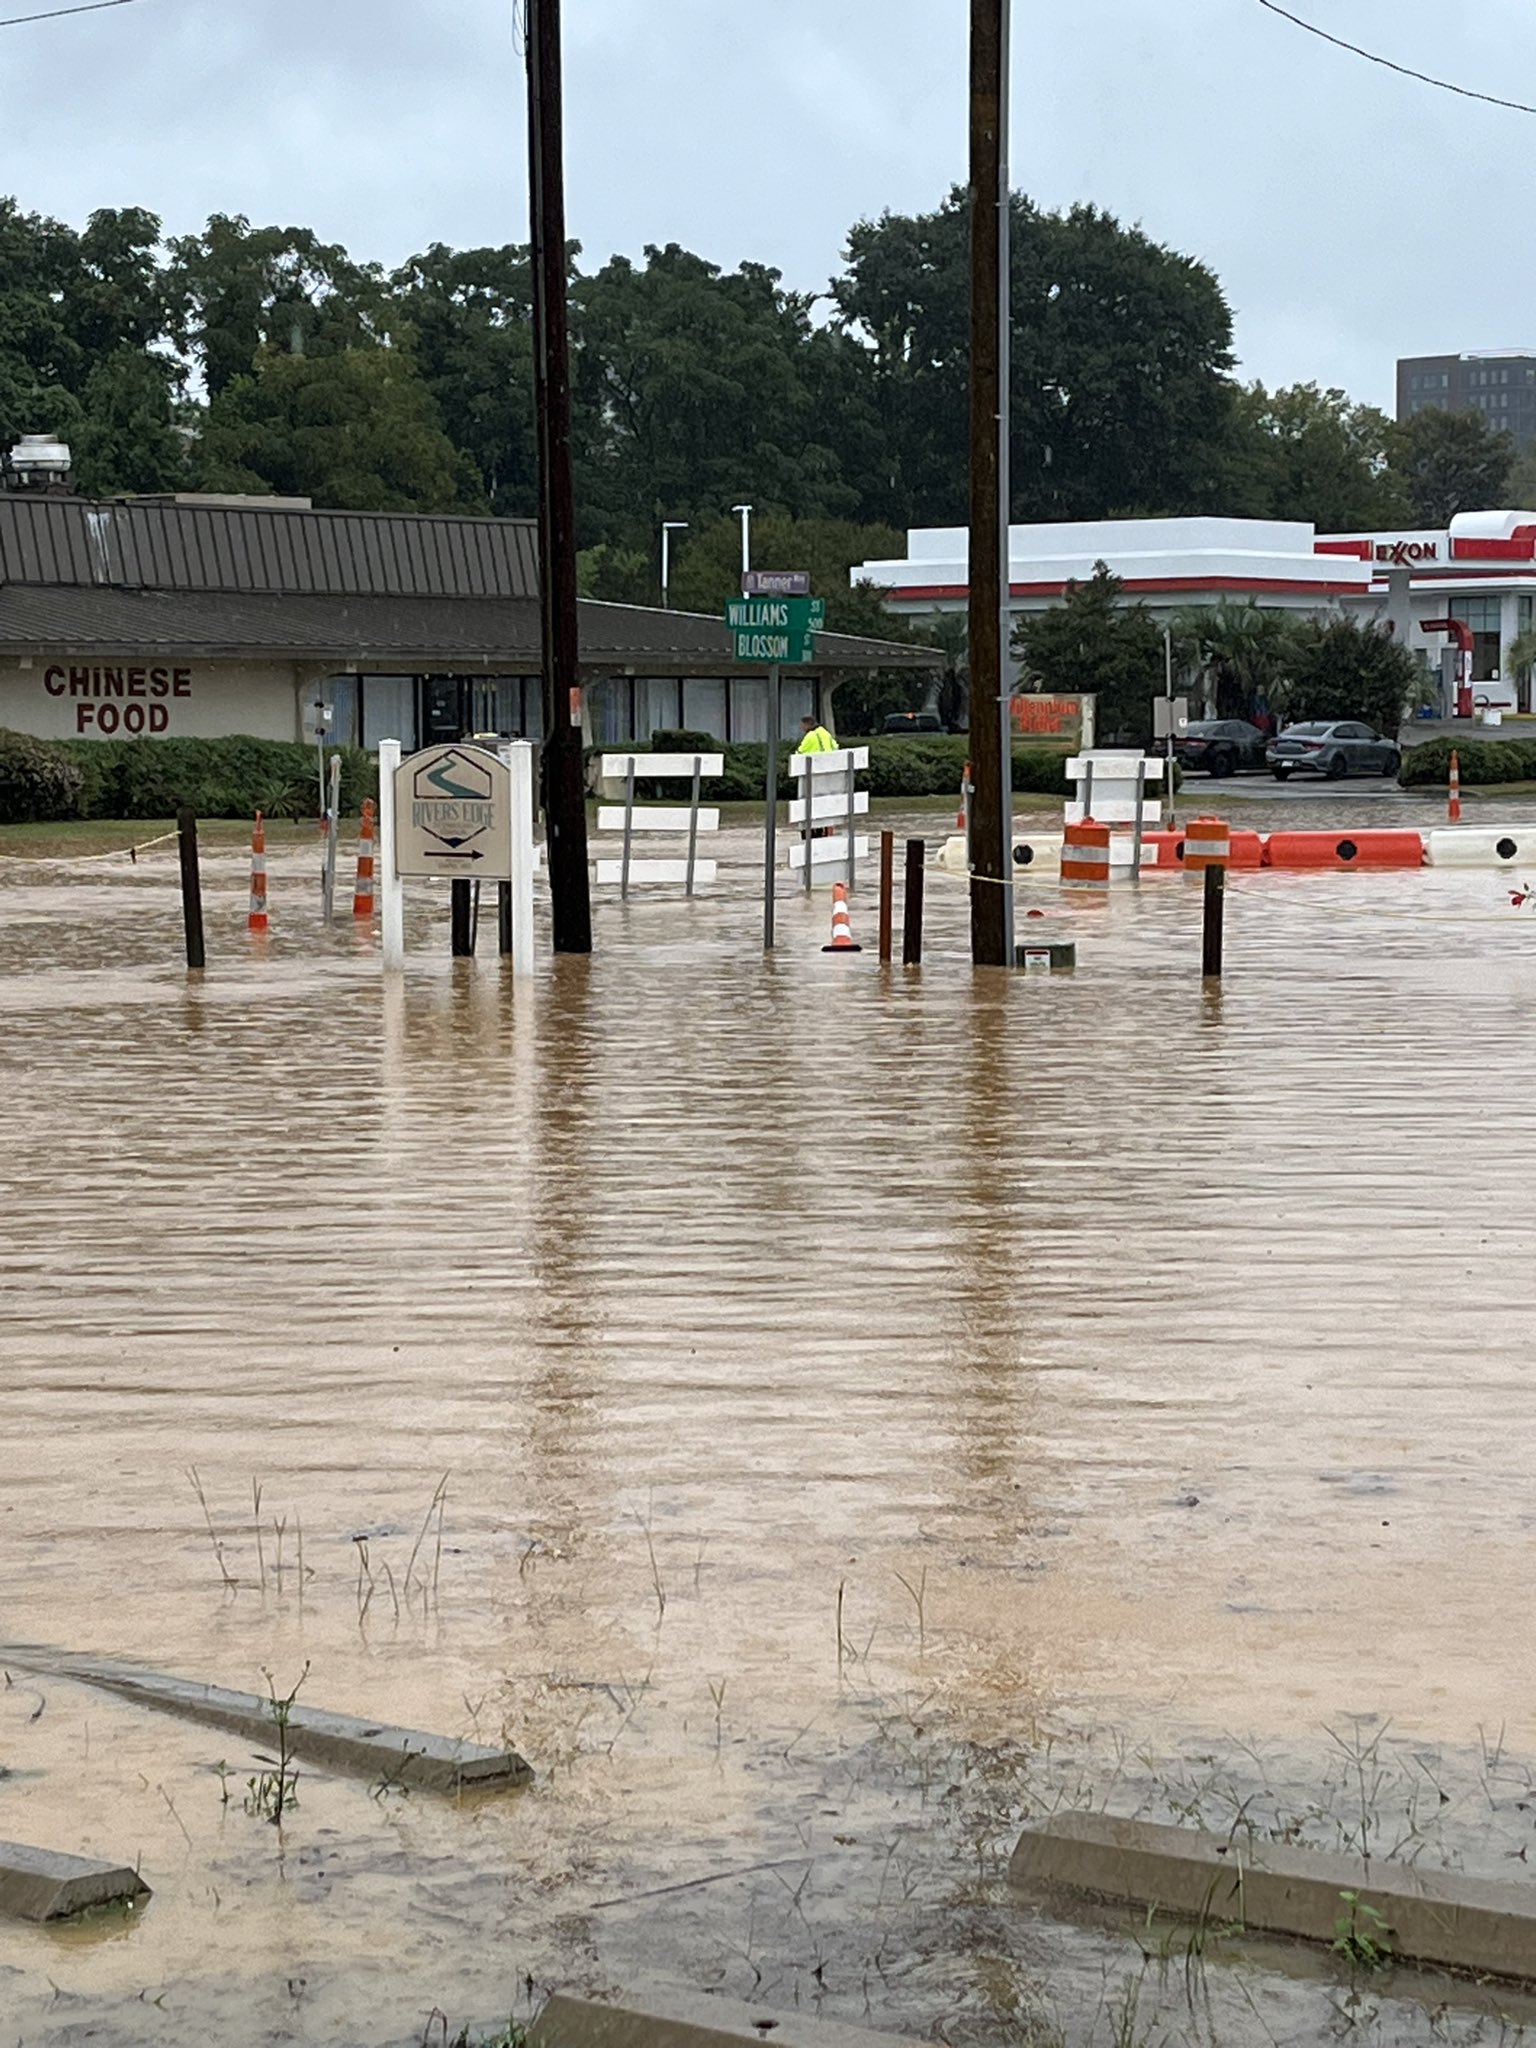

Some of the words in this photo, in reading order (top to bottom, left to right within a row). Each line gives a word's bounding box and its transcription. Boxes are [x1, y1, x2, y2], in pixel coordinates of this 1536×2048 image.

[1376, 541, 1437, 568] EXXON
[757, 573, 792, 590] Tanner
[728, 603, 788, 626] WILLIAMS
[738, 633, 788, 658] BLOSSOM
[44, 665, 191, 697] CHINESE
[77, 703, 169, 734] FOOD
[412, 802, 459, 828] RIVERS
[462, 803, 496, 831] EDGE
